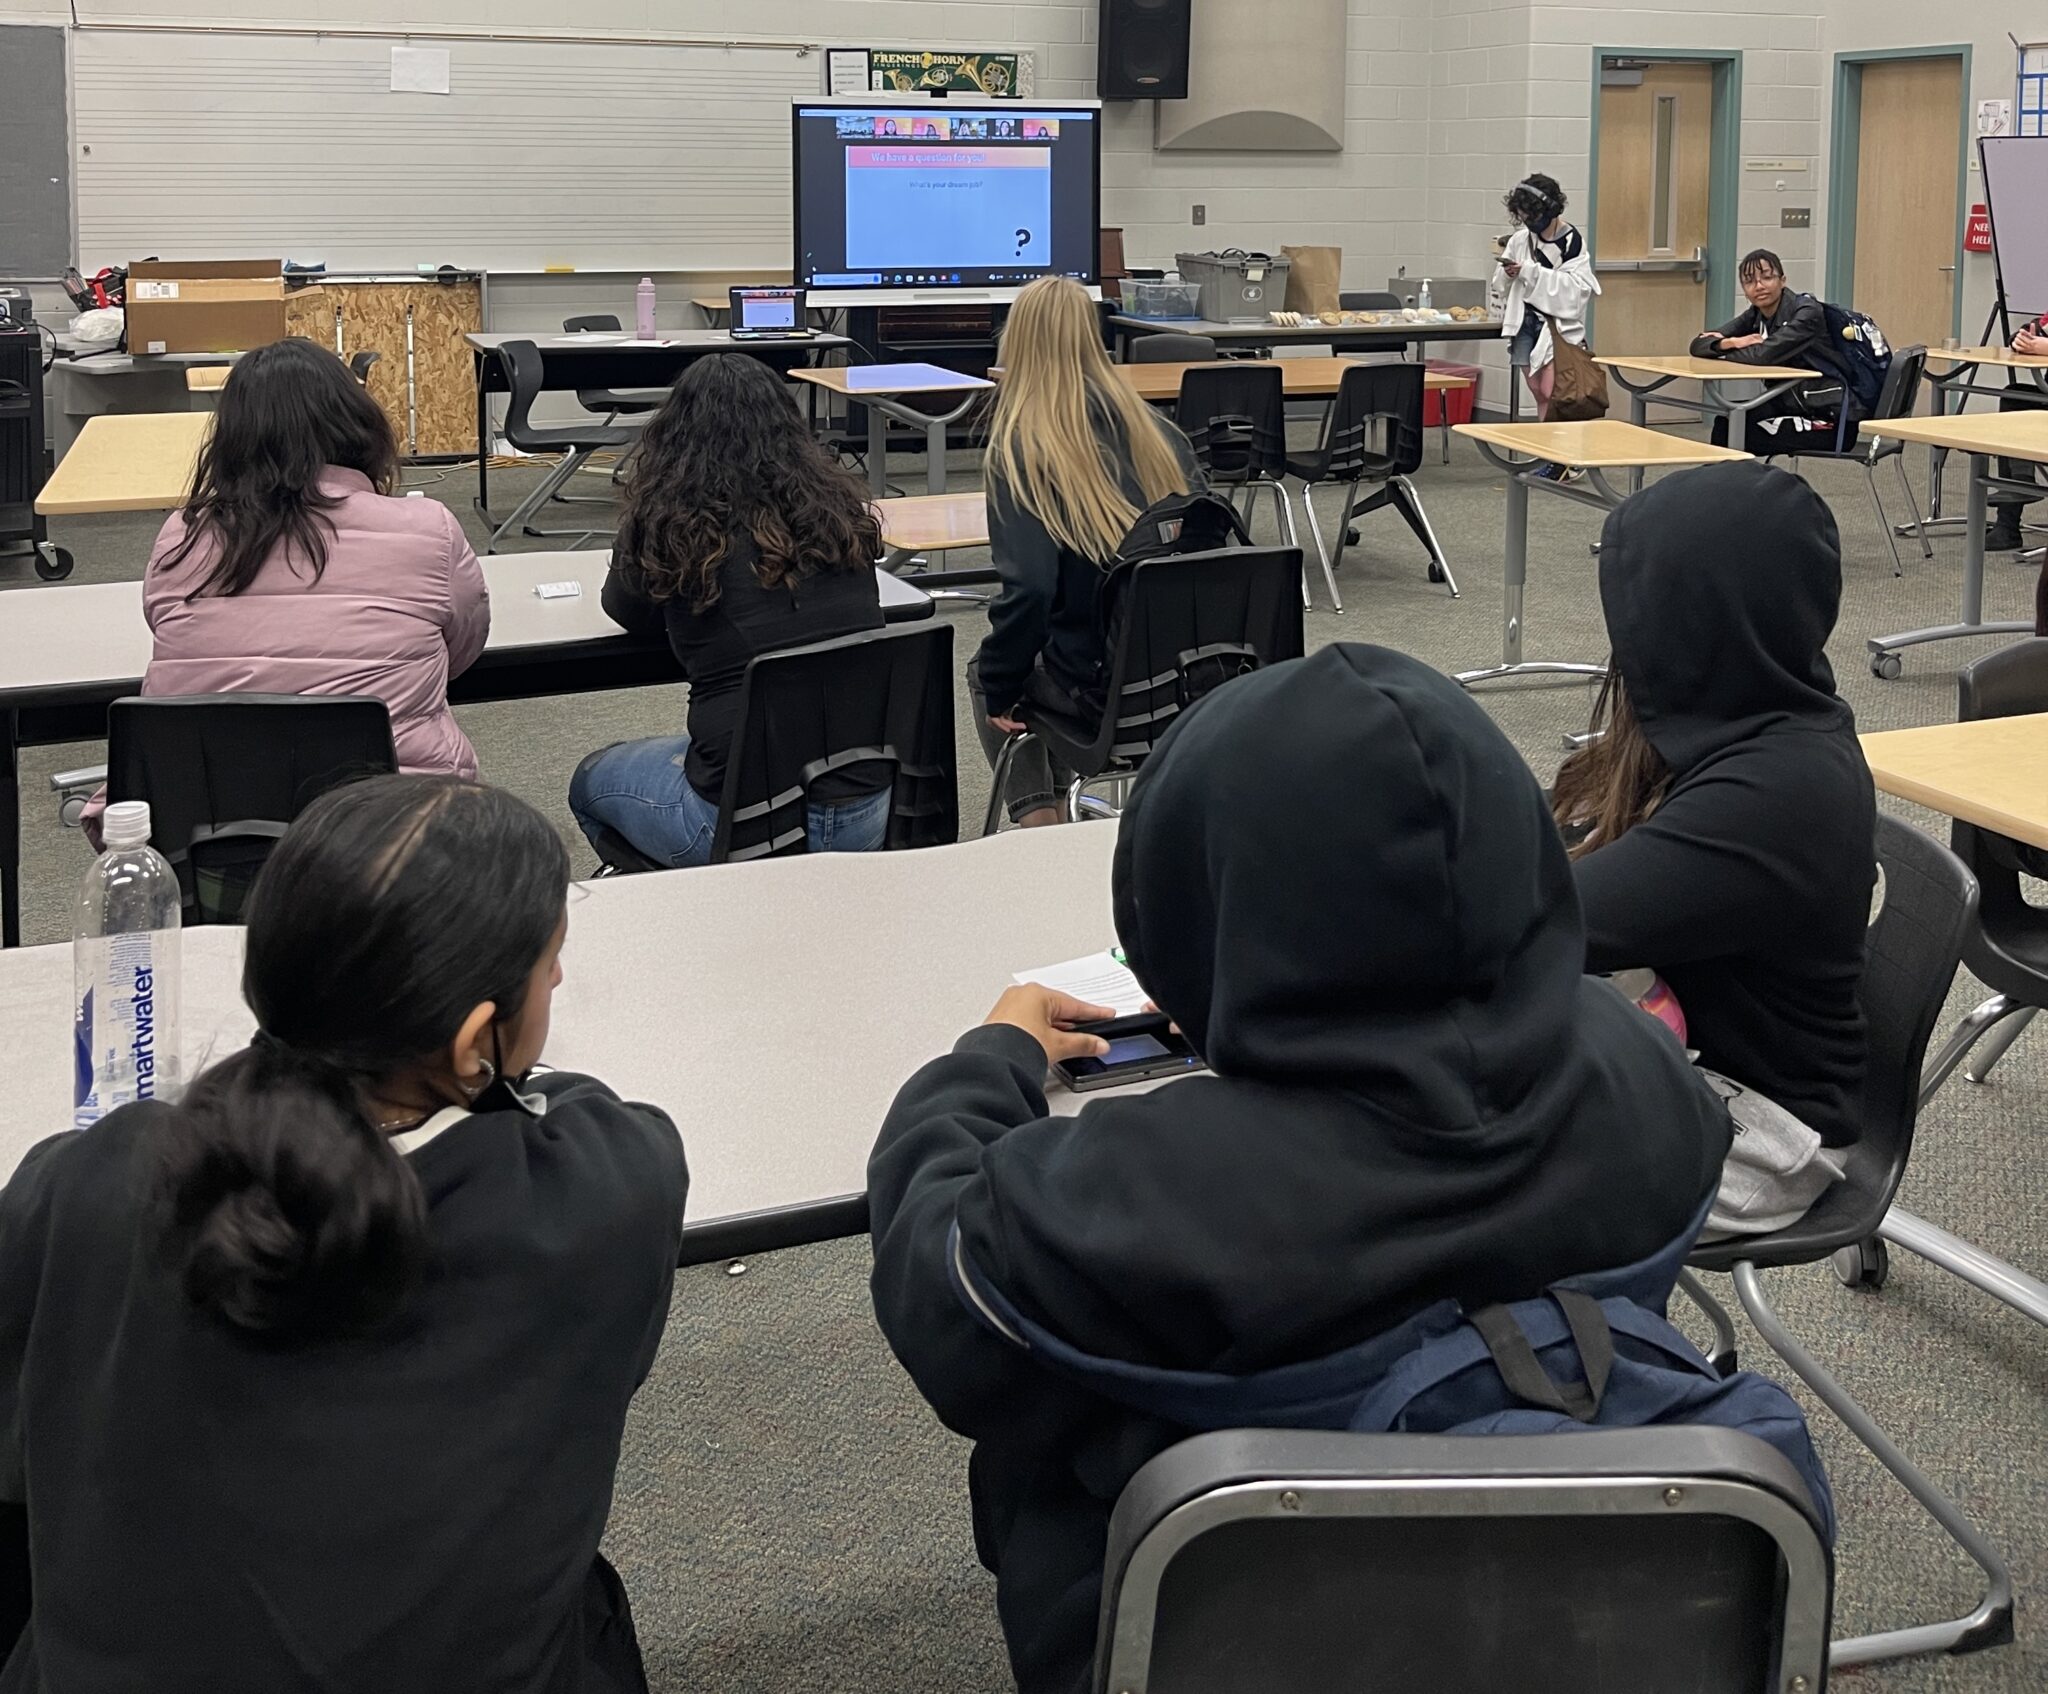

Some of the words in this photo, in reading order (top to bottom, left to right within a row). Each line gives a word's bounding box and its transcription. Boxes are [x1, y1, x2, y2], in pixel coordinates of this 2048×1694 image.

[873, 54, 920, 64] FRENCH
[933, 55, 966, 65] HORN
[871, 153, 885, 162] We
[887, 153, 907, 162] have
[915, 153, 952, 164] question
[953, 153, 966, 162] for
[967, 153, 985, 164] you!
[969, 181, 983, 189] job?
[1974, 223, 1989, 232] NEE
[130, 966, 154, 1100] martwater
